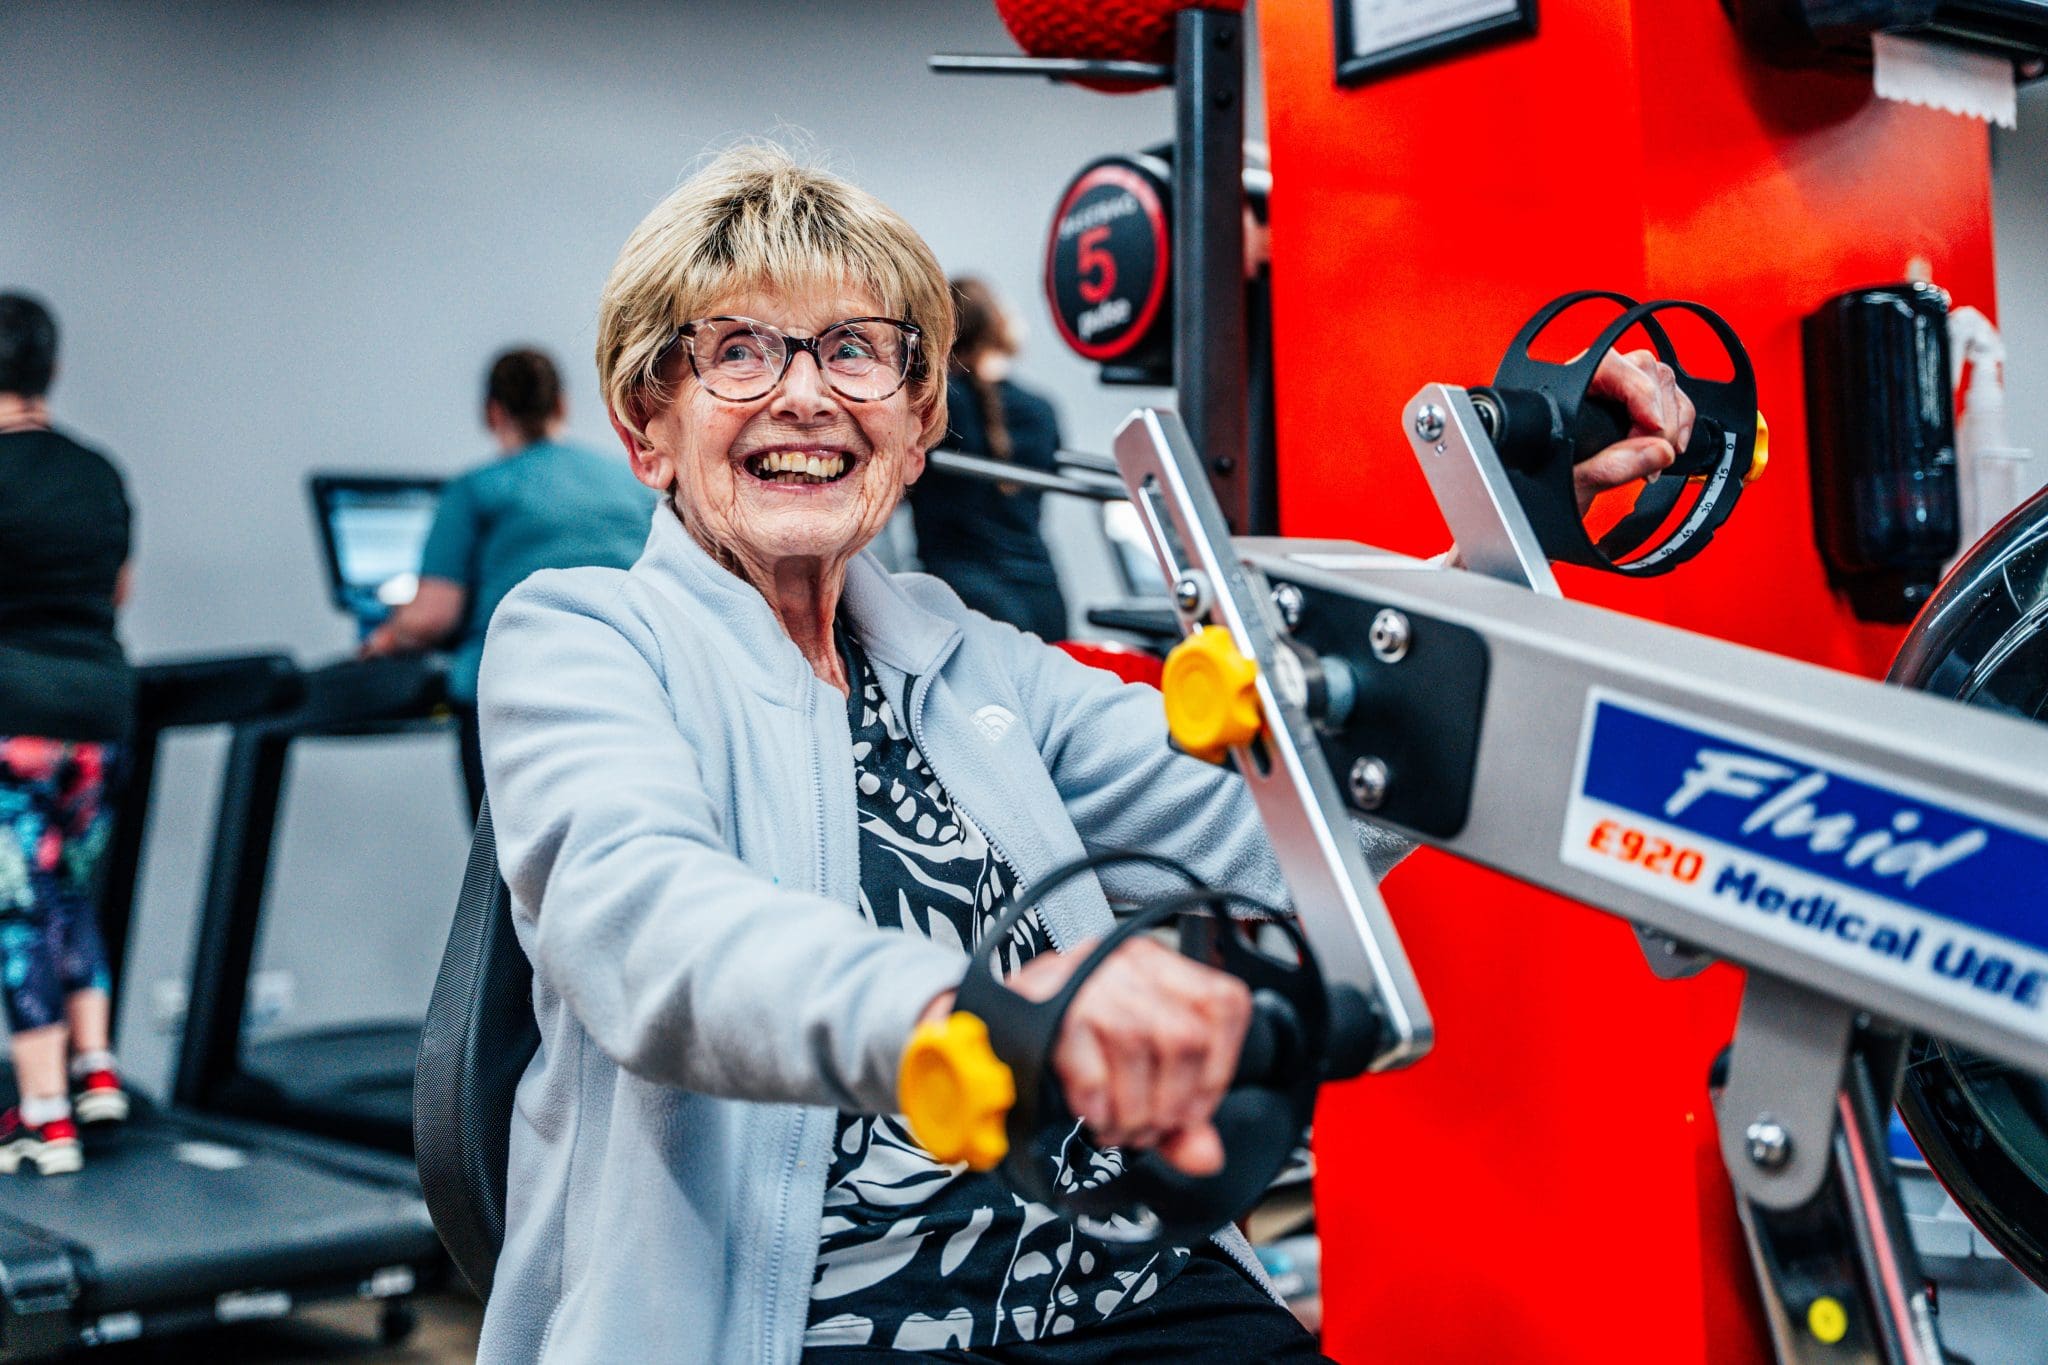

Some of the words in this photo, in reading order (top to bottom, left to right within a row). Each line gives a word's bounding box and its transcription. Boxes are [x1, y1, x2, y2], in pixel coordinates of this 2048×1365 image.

[1077, 224, 1117, 302] 5
[1718, 467, 1729, 481] 15
[1664, 748, 1988, 889] Fluid
[1587, 819, 1705, 886] E920
[1713, 863, 1924, 964] Medical
